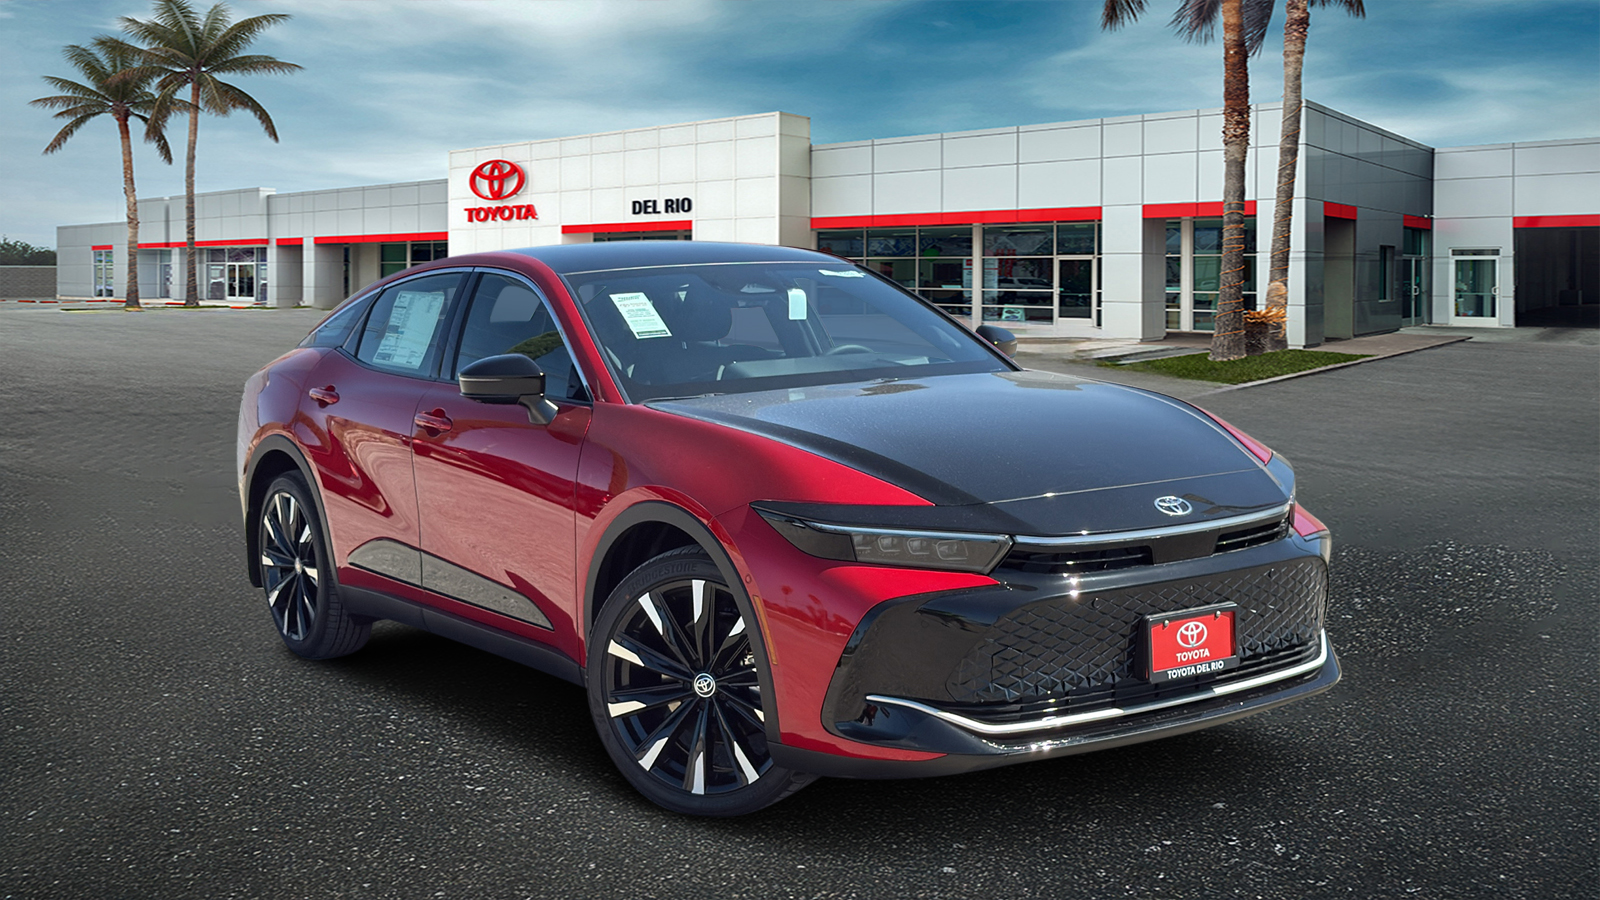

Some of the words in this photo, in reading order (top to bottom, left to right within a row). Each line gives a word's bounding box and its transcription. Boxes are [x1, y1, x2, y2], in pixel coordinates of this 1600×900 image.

[464, 204, 538, 222] TOYOTA
[632, 200, 661, 215] DEL
[664, 197, 693, 214] RIO
[627, 562, 697, 592] BRIDGESTONE
[1176, 648, 1210, 662] TOYOTA
[1167, 666, 1195, 679] TOYOTA
[1196, 663, 1211, 674] DEL
[1211, 660, 1224, 671] RIO
